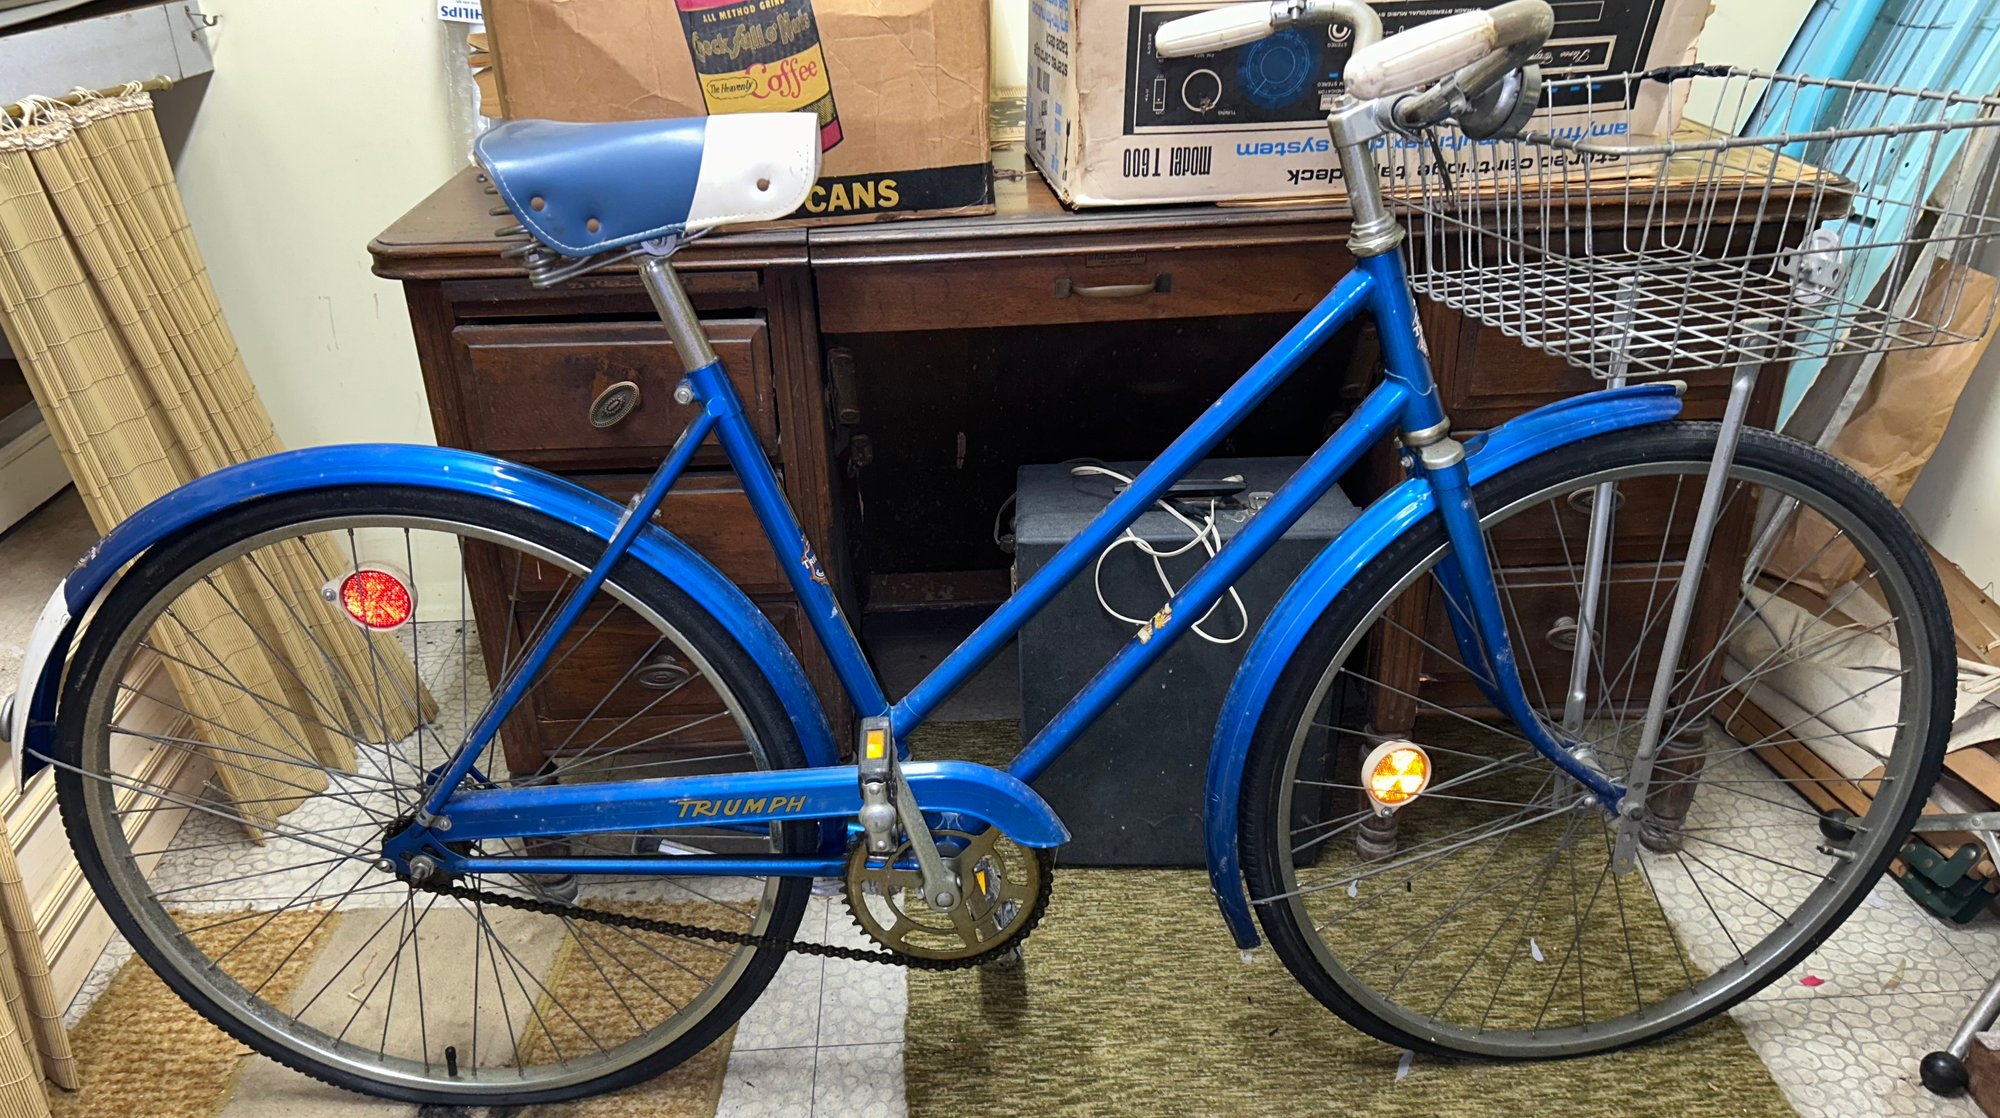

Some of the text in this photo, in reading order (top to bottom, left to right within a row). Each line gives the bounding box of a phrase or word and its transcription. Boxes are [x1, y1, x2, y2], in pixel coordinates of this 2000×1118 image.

[441, 5, 483, 19] HILIPS
[702, 13, 717, 23] ALL
[718, 4, 756, 20] METHOD
[776, 9, 810, 45] Nuts
[1560, 49, 1591, 63] Stereo
[710, 79, 753, 93] The Heavenly
[745, 57, 817, 99] Coffee
[1236, 137, 1330, 157] system
[1169, 147, 1212, 176] model
[1286, 169, 1343, 186] deck
[805, 179, 899, 213] CANS
[677, 795, 806, 818] TRIUMPH
